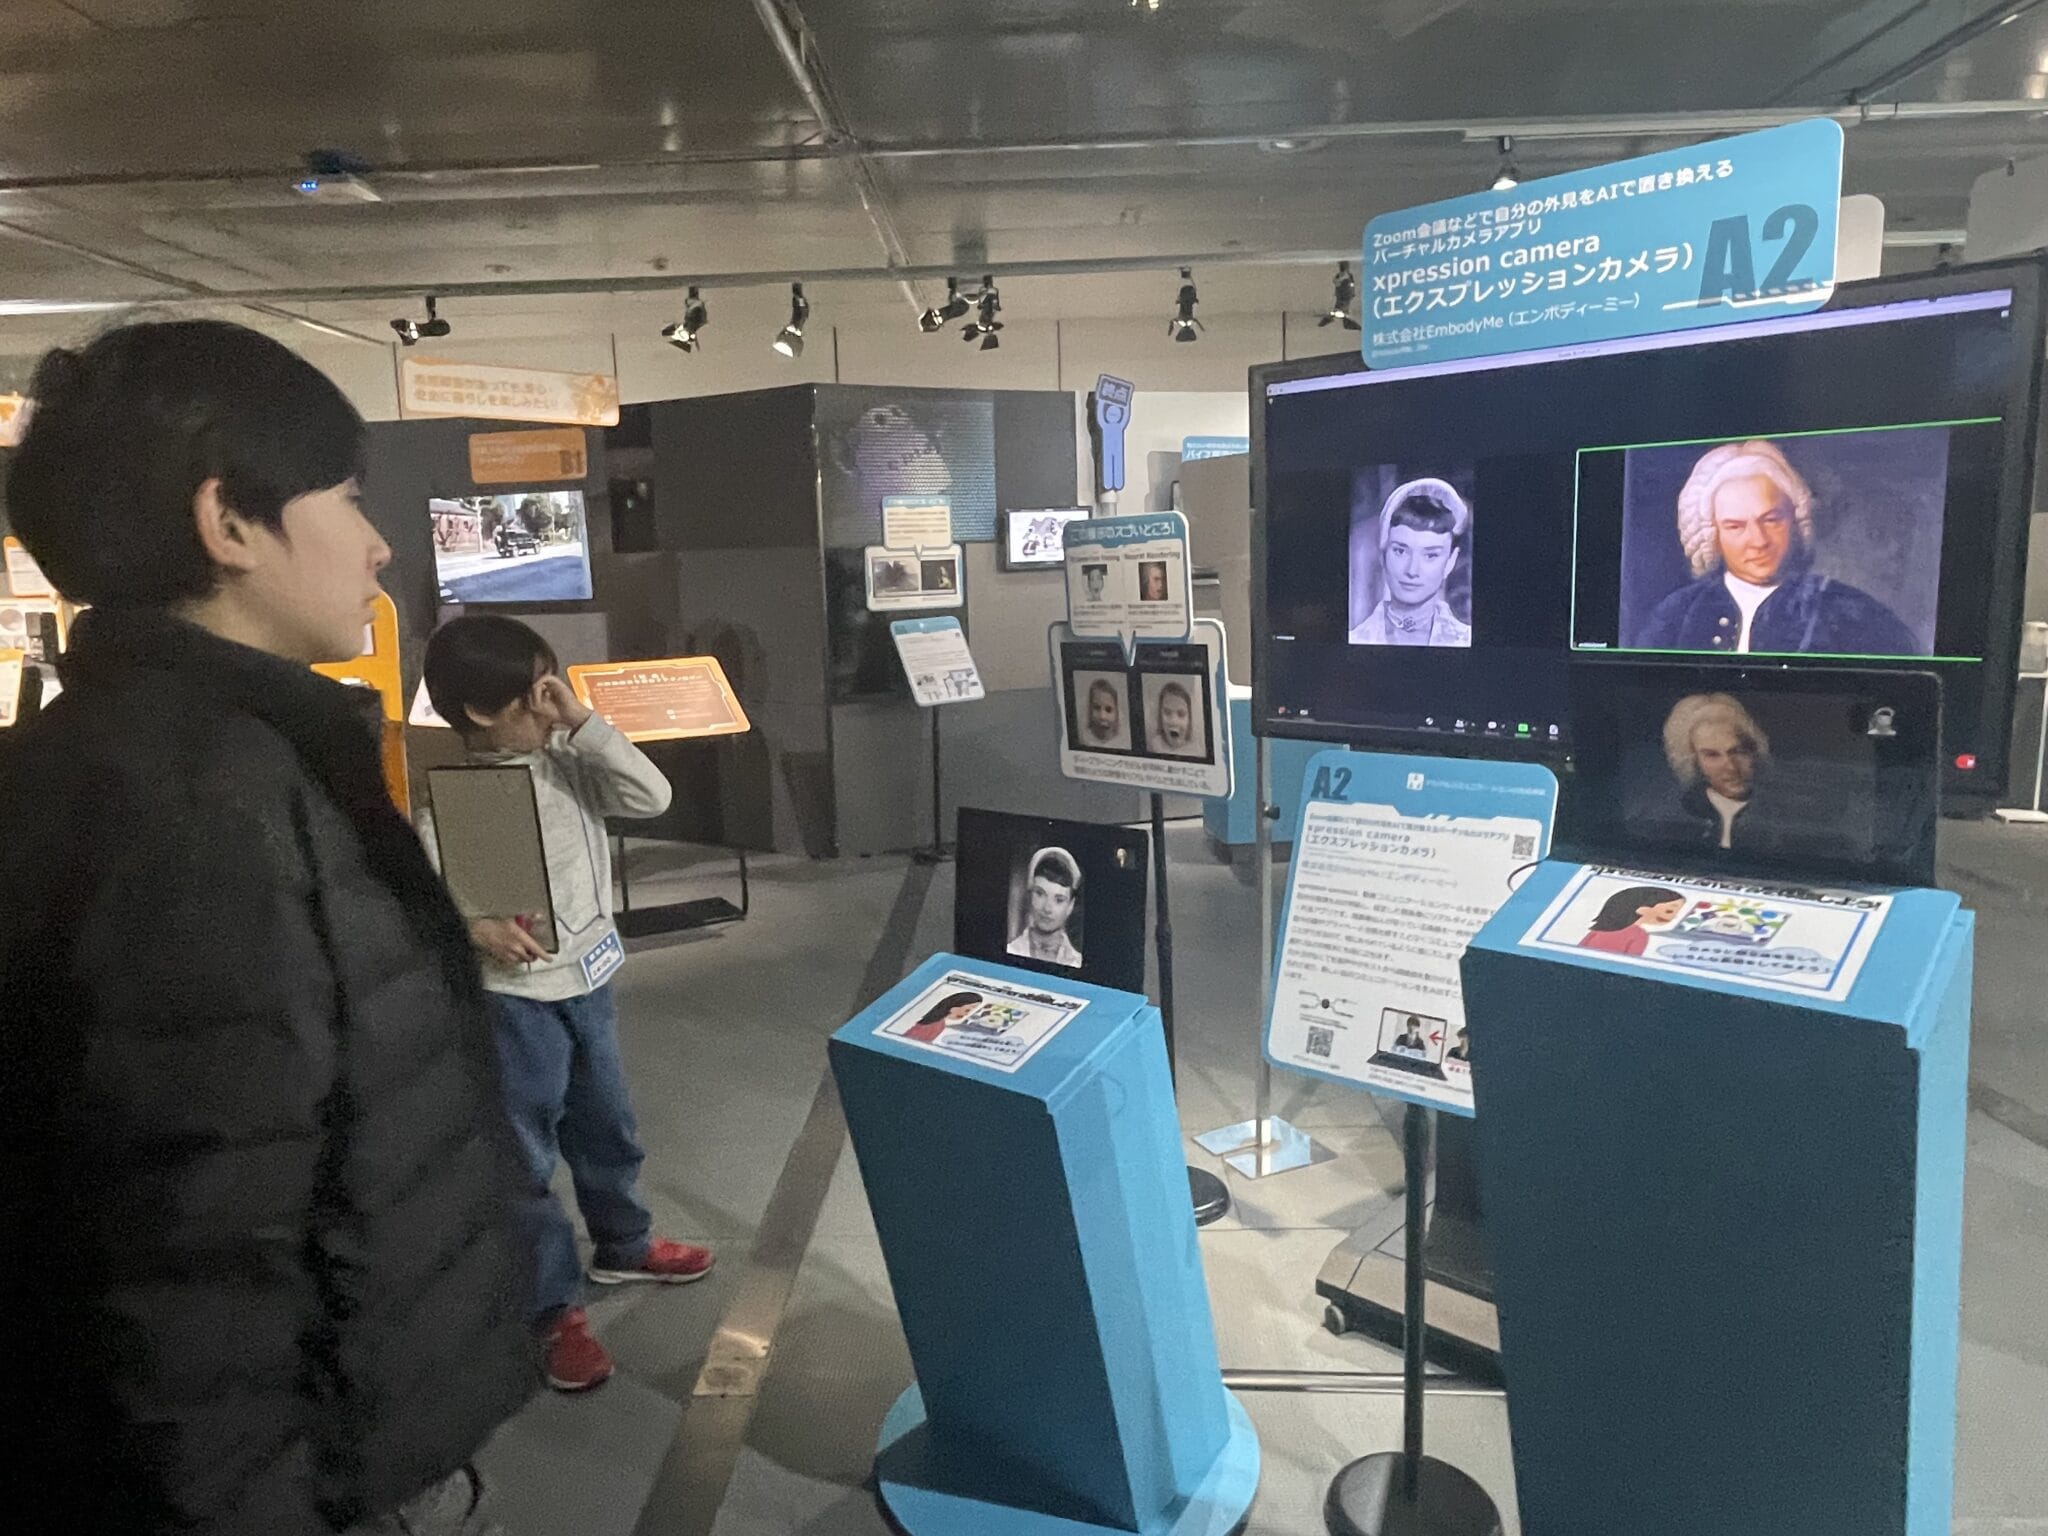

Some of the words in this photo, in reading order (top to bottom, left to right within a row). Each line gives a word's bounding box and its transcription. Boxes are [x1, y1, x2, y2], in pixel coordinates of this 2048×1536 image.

[1373, 217, 1542, 264] バーチャルカメラアプリ
[1373, 252, 1491, 292] xpression
[1499, 234, 1601, 269] camera
[1697, 204, 1819, 308] A2
[1310, 766, 1352, 800] A2
[1307, 823, 1363, 838] xpression
[1366, 830, 1411, 843] camera
